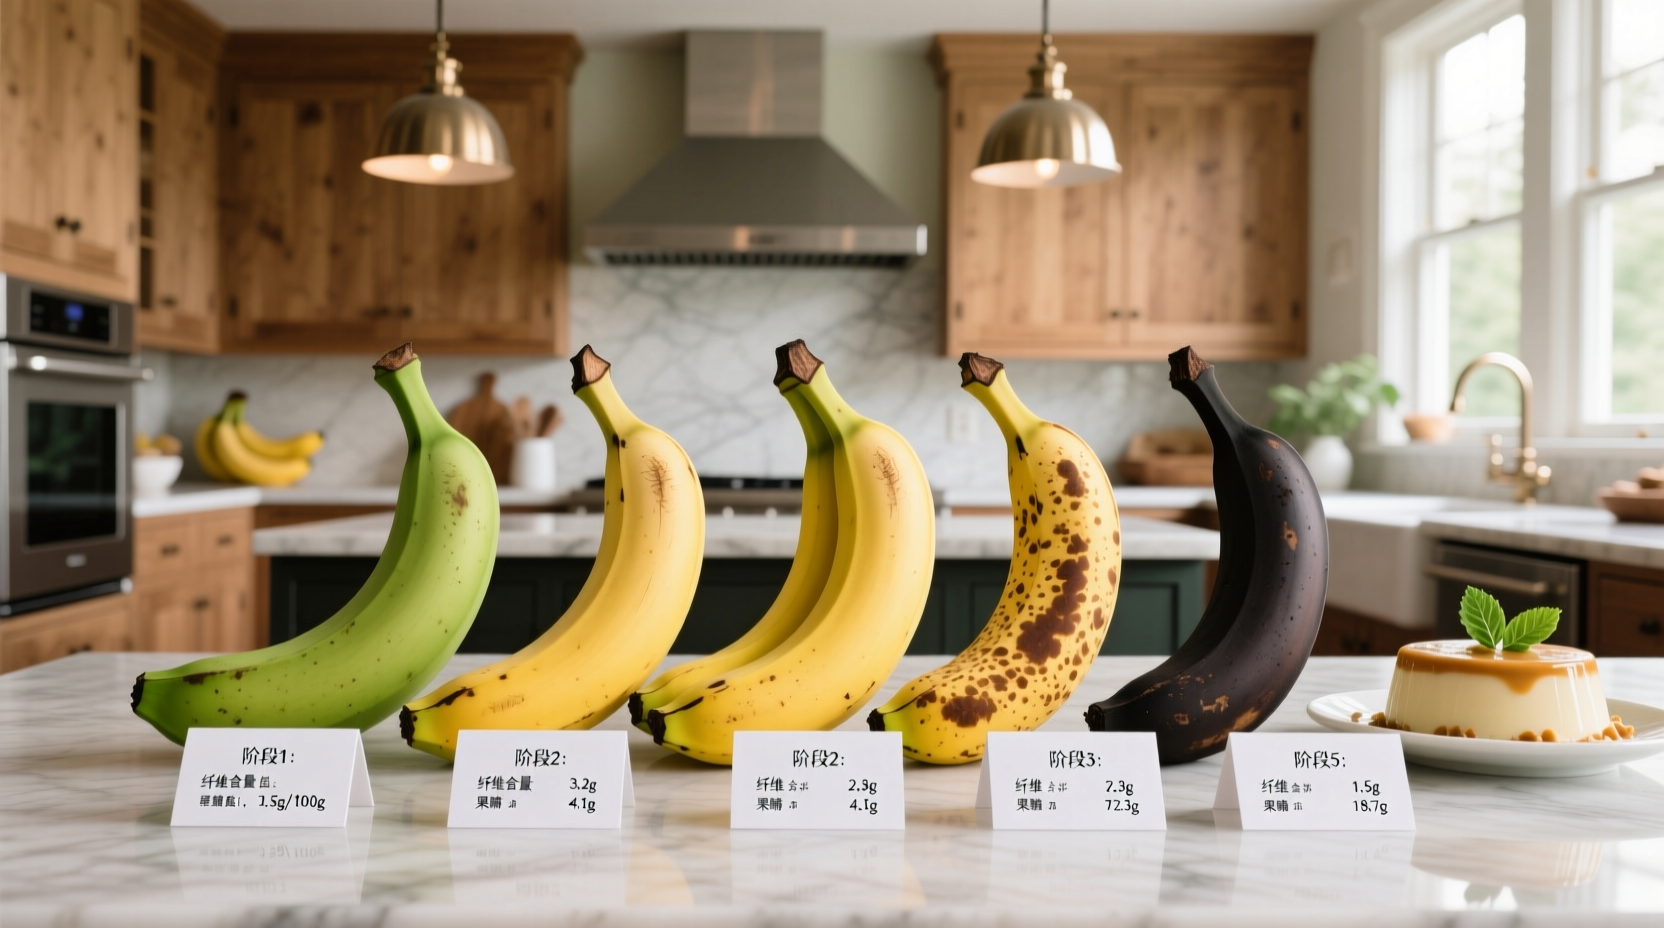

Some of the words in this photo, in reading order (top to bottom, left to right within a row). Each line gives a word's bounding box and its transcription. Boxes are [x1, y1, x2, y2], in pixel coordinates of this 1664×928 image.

[242, 746, 295, 766] 阶段1:
[515, 748, 566, 768] 阶段2:
[792, 749, 845, 768] 阶段2:
[1049, 749, 1101, 769] 阶段3:
[1294, 750, 1346, 769] 阶段5:
[569, 777, 597, 793] 3.2g
[1352, 780, 1380, 796] 1.5g
[568, 797, 596, 814] 4.1g
